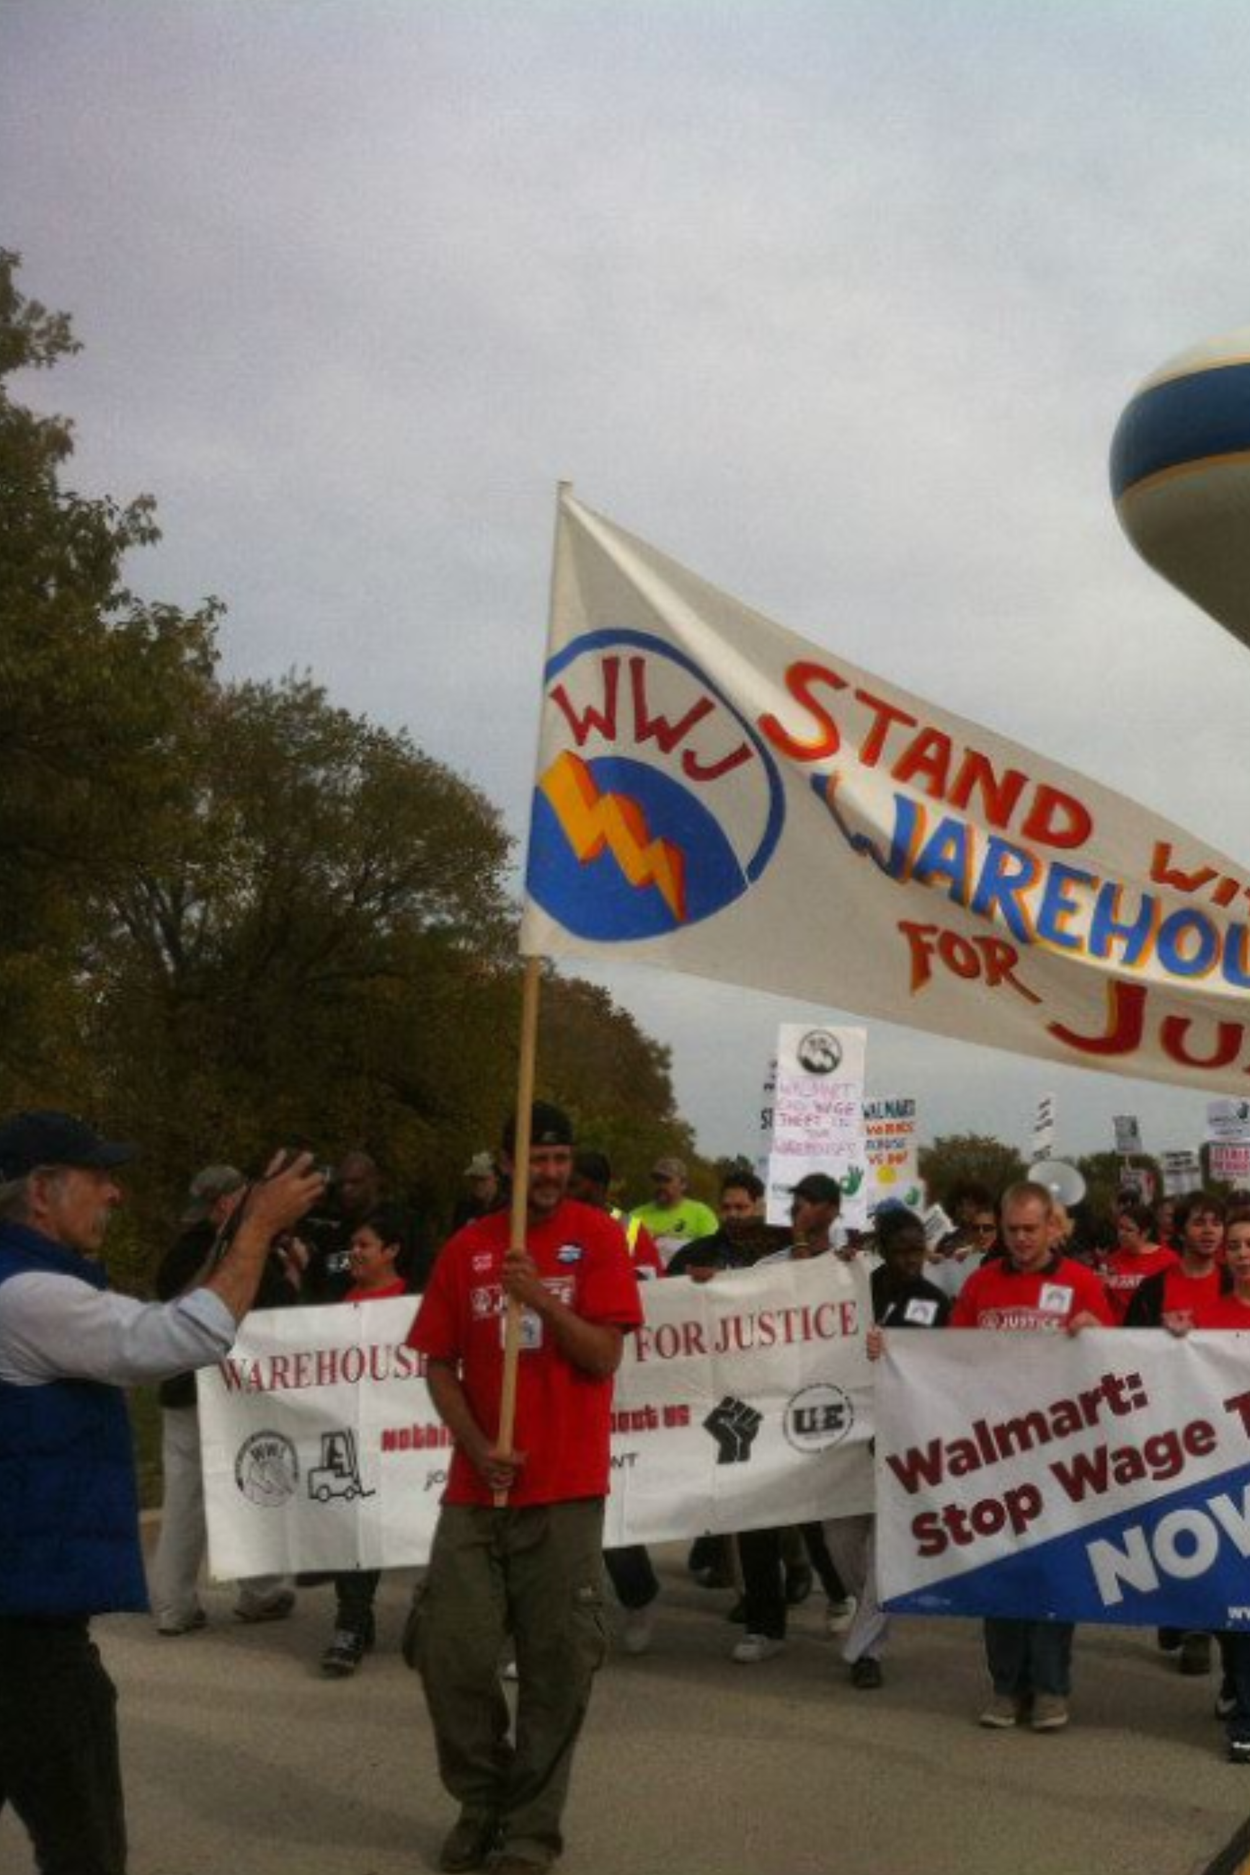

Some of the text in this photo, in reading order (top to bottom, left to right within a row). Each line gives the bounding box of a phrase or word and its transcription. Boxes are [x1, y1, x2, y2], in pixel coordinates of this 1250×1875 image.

[549, 656, 754, 782] WWJ
[757, 659, 1093, 850] STAND
[897, 919, 1042, 1004] FOR
[634, 1321, 708, 1362] FOR
[714, 1301, 859, 1354] JUSTICE
[793, 1404, 844, 1435] UE
[886, 1371, 1148, 1494] Walmart:
[911, 1490, 1043, 1558] Stop
[1050, 1419, 1217, 1502] Wage
